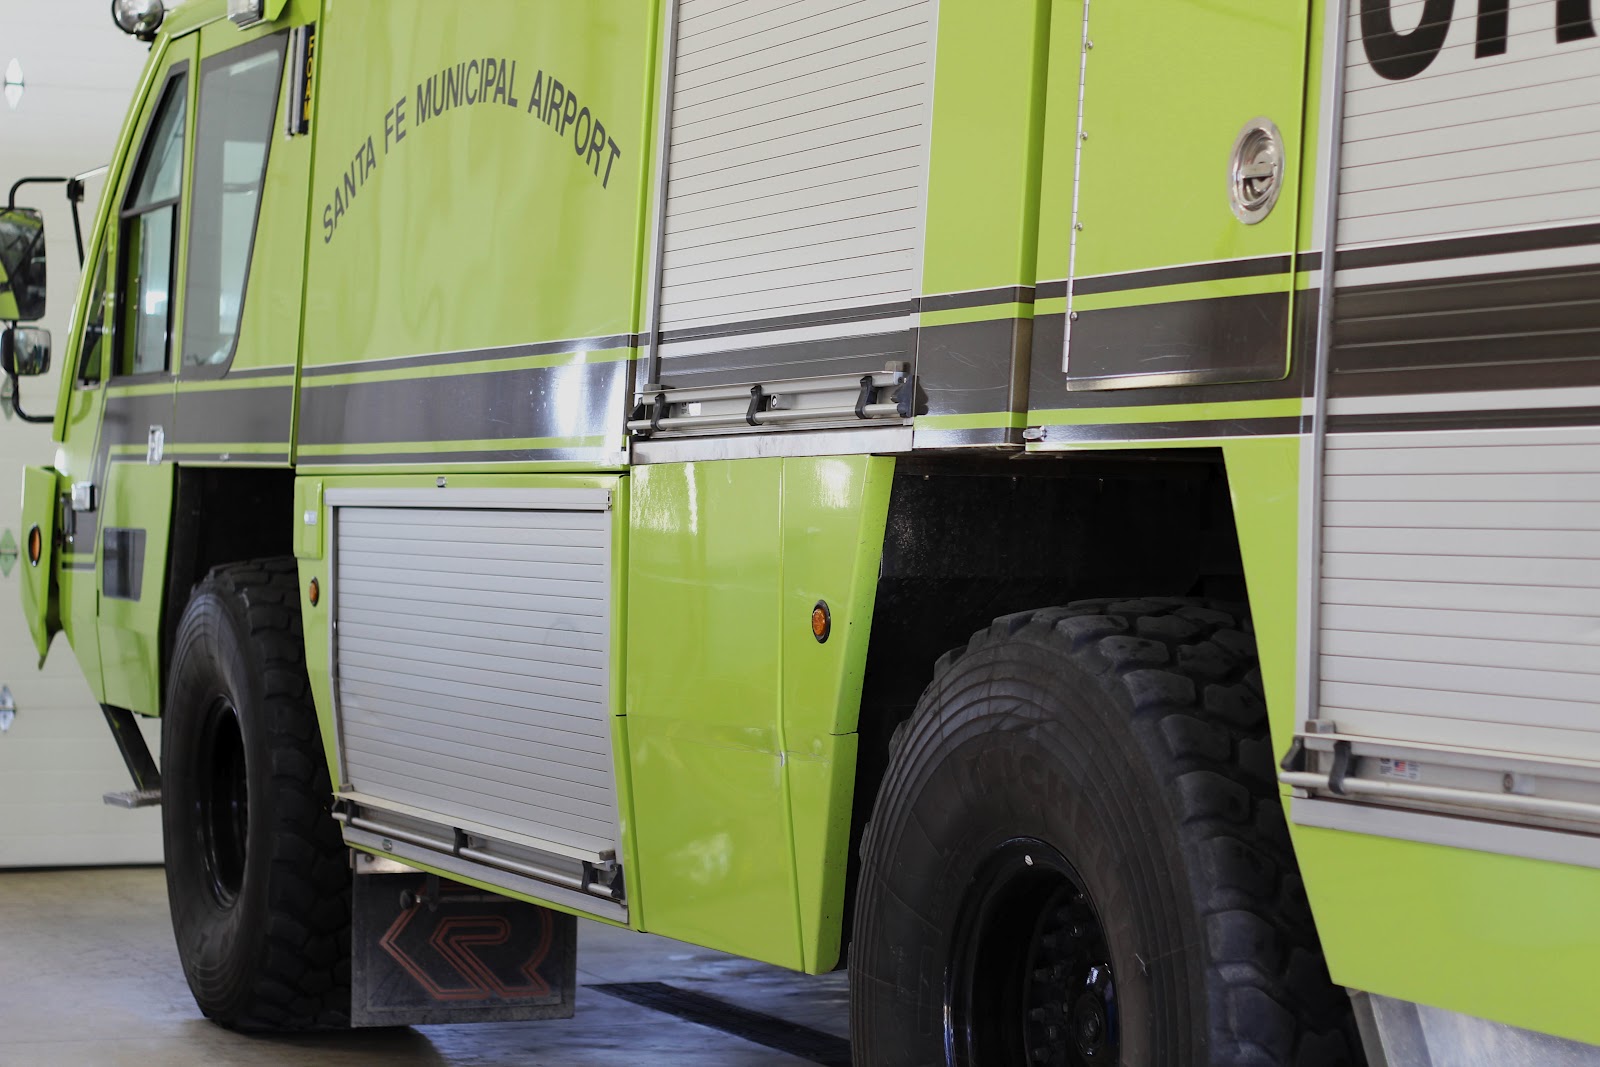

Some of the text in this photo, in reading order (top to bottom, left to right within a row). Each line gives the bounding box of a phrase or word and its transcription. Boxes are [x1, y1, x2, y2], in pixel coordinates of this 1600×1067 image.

[323, 57, 621, 243] SANTA FE MUNICIPAL AIRPORT
